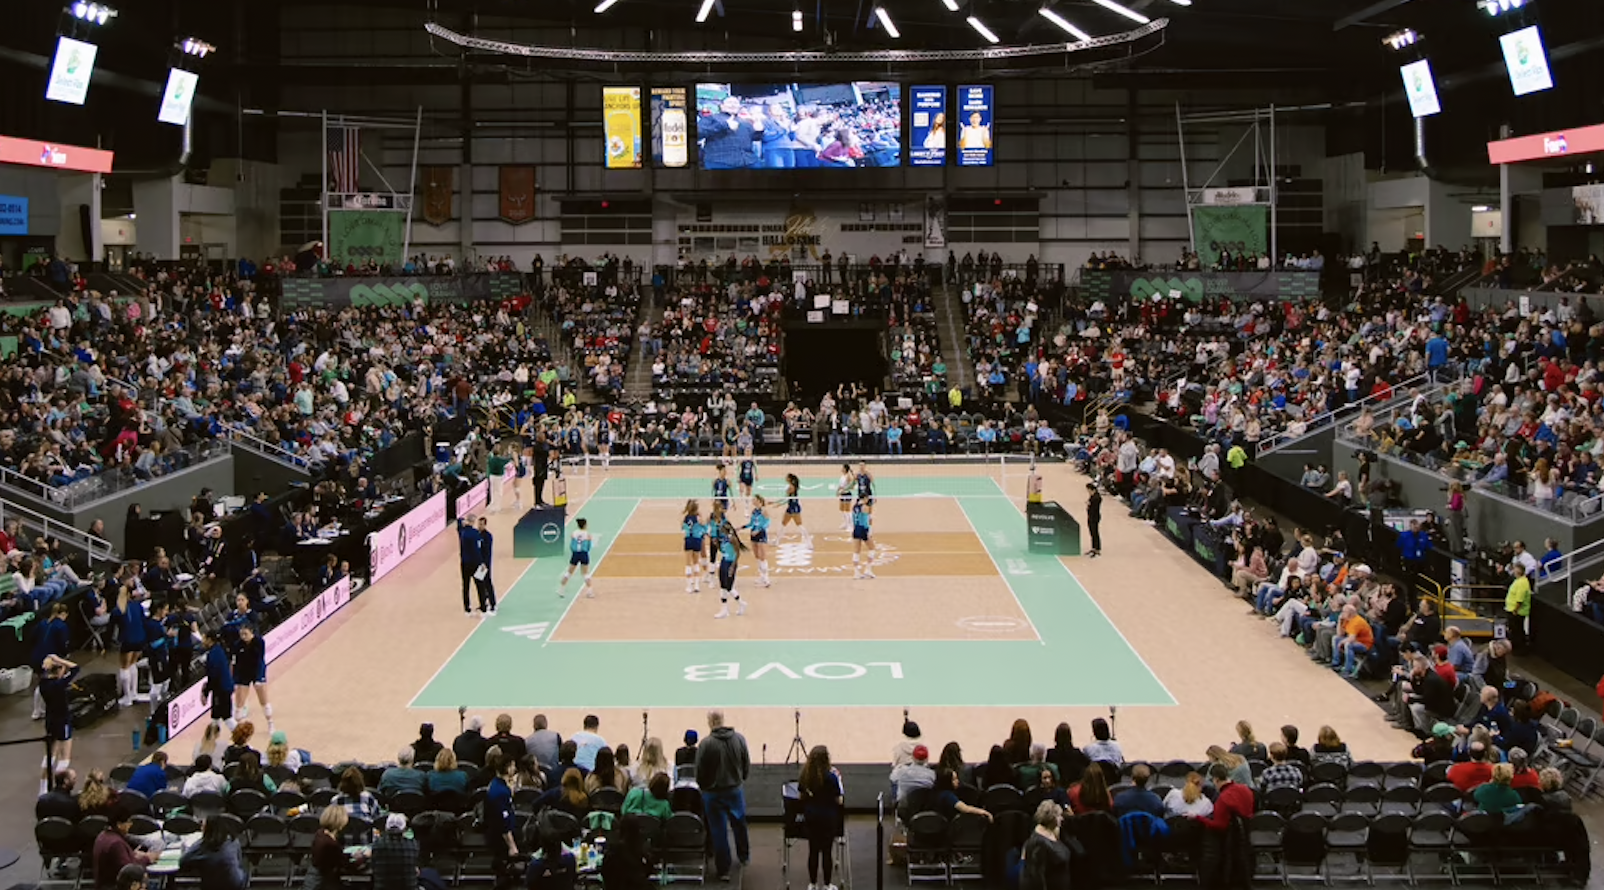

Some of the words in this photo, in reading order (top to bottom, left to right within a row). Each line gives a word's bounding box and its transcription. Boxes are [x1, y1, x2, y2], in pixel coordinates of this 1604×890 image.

[762, 235, 785, 246] HALL
[796, 235, 821, 246] FAME
[683, 662, 904, 682] LOVB
